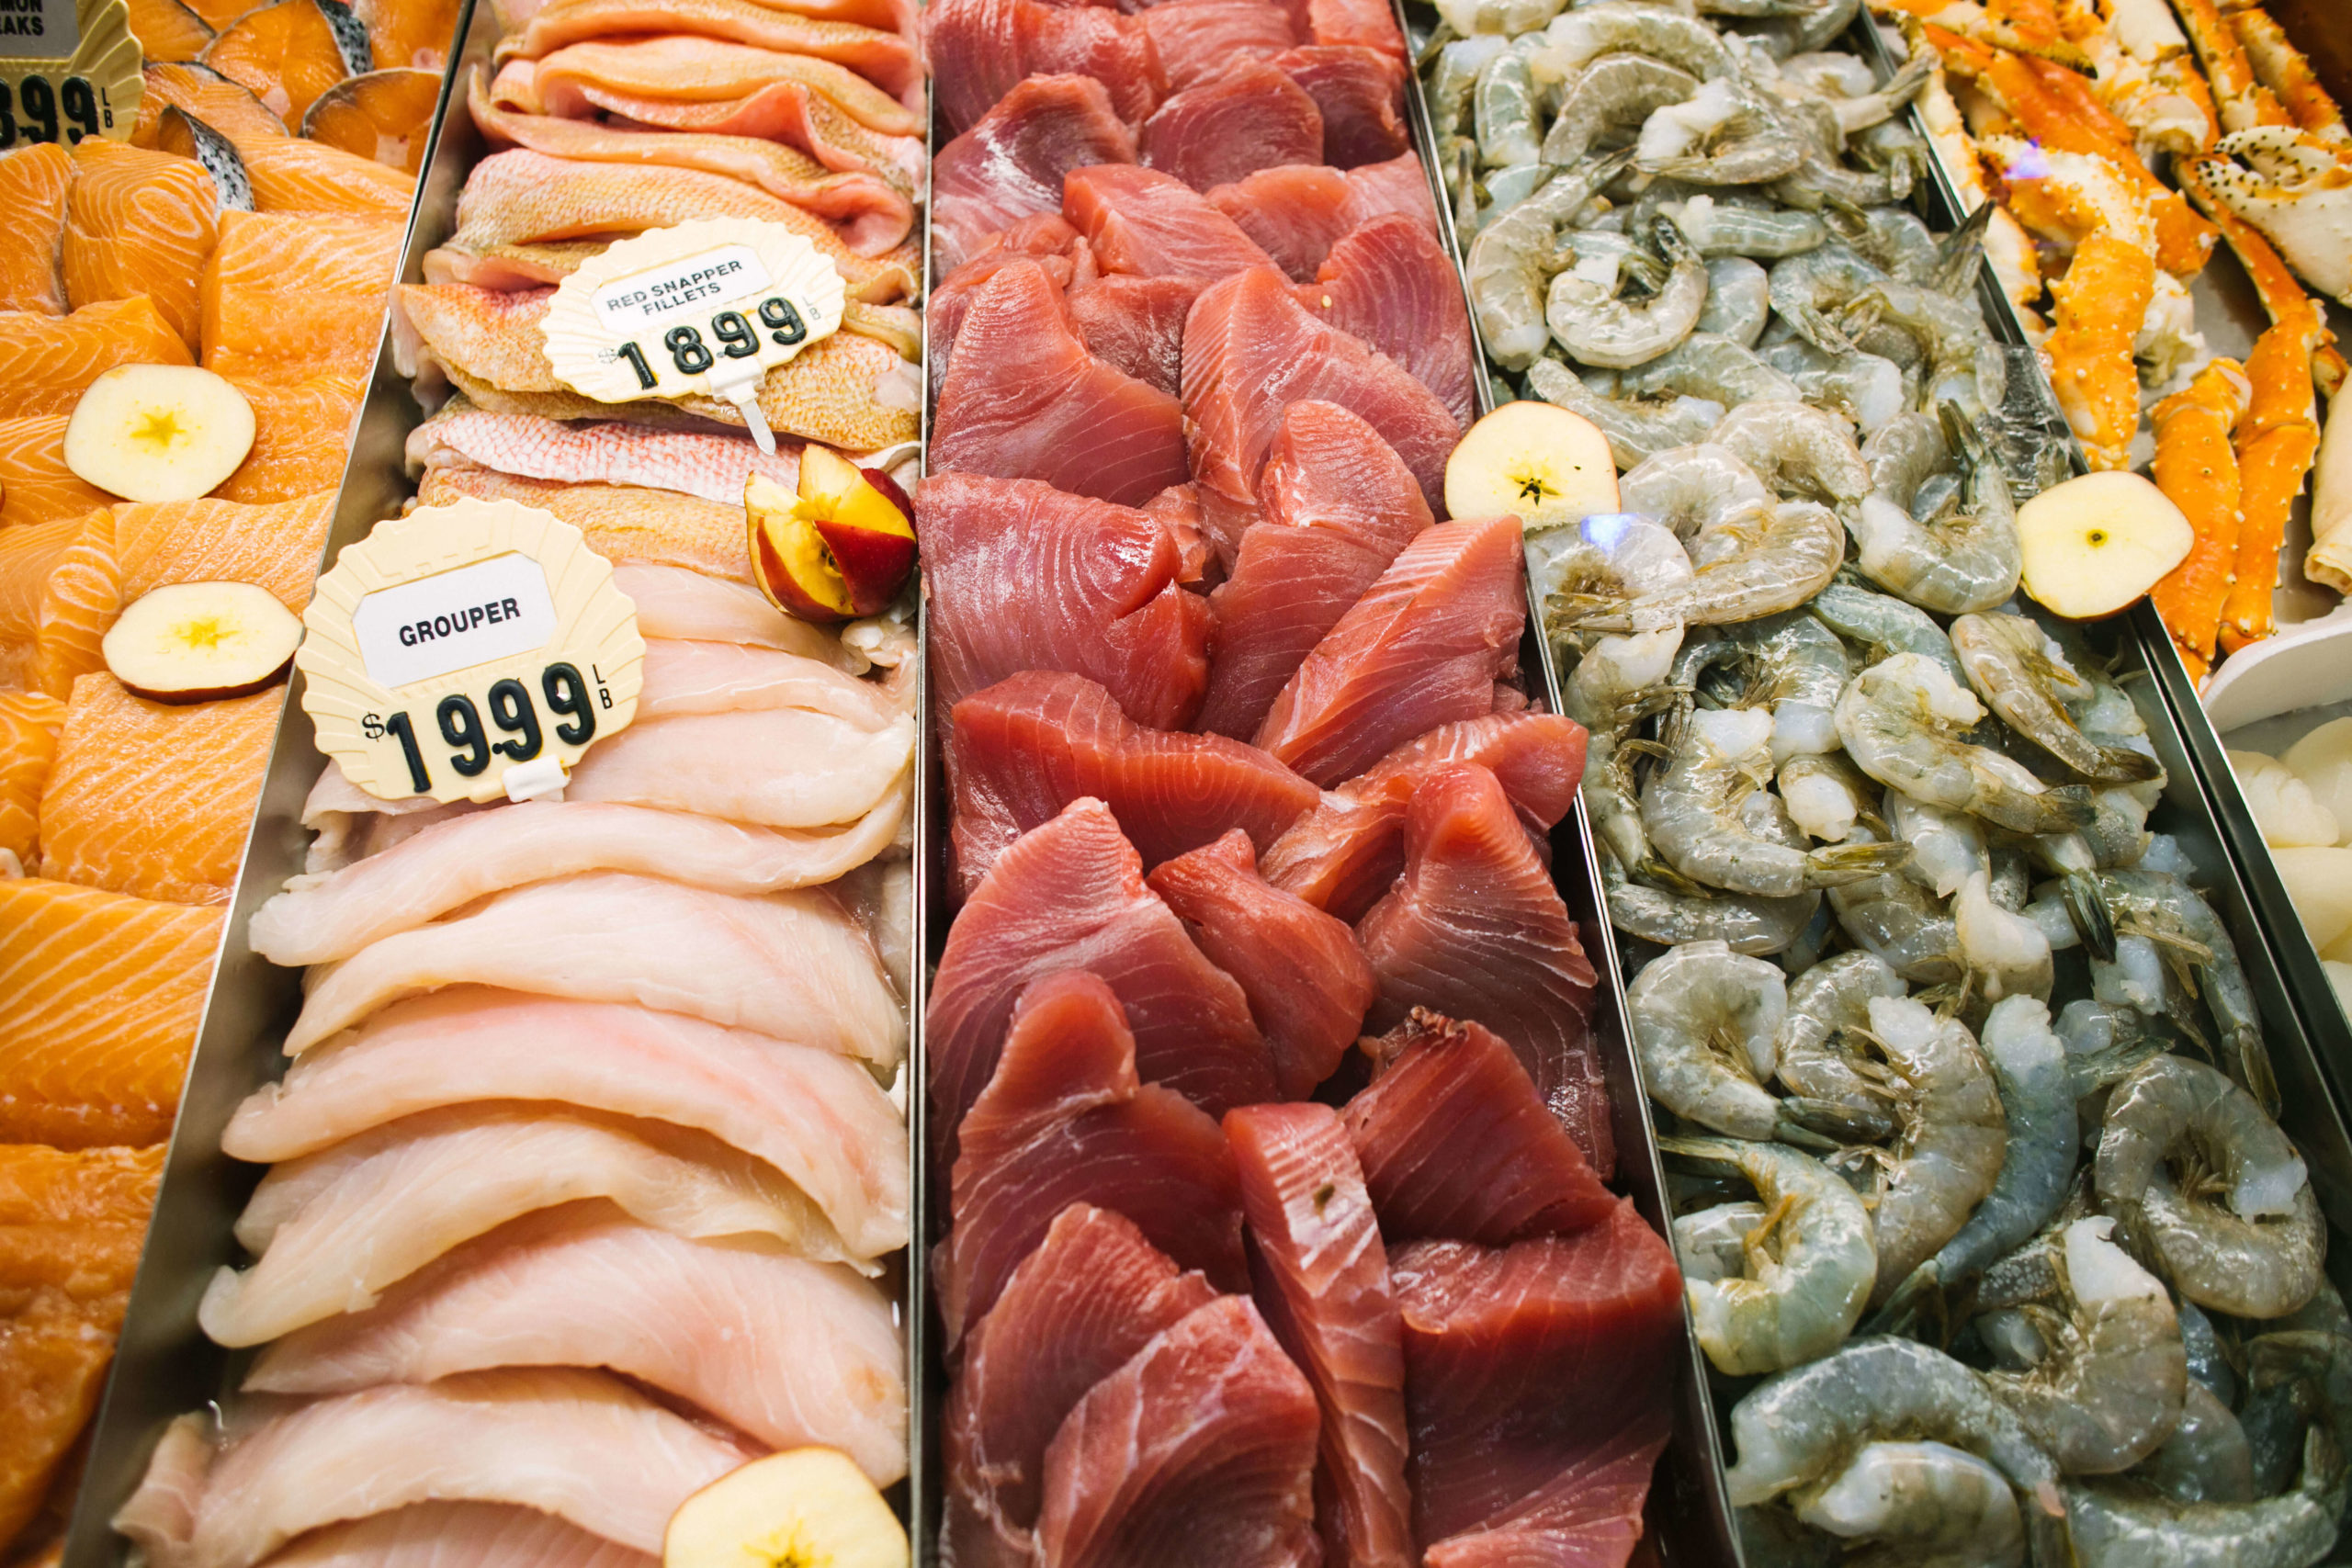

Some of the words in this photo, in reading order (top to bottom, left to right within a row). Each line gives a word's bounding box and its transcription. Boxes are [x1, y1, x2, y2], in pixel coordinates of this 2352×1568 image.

[0, 16, 44, 36] AKS
[606, 288, 647, 311] RED
[651, 260, 743, 297] SNAPPER
[642, 282, 721, 316] FILLETS
[399, 597, 521, 647] GROUPER
